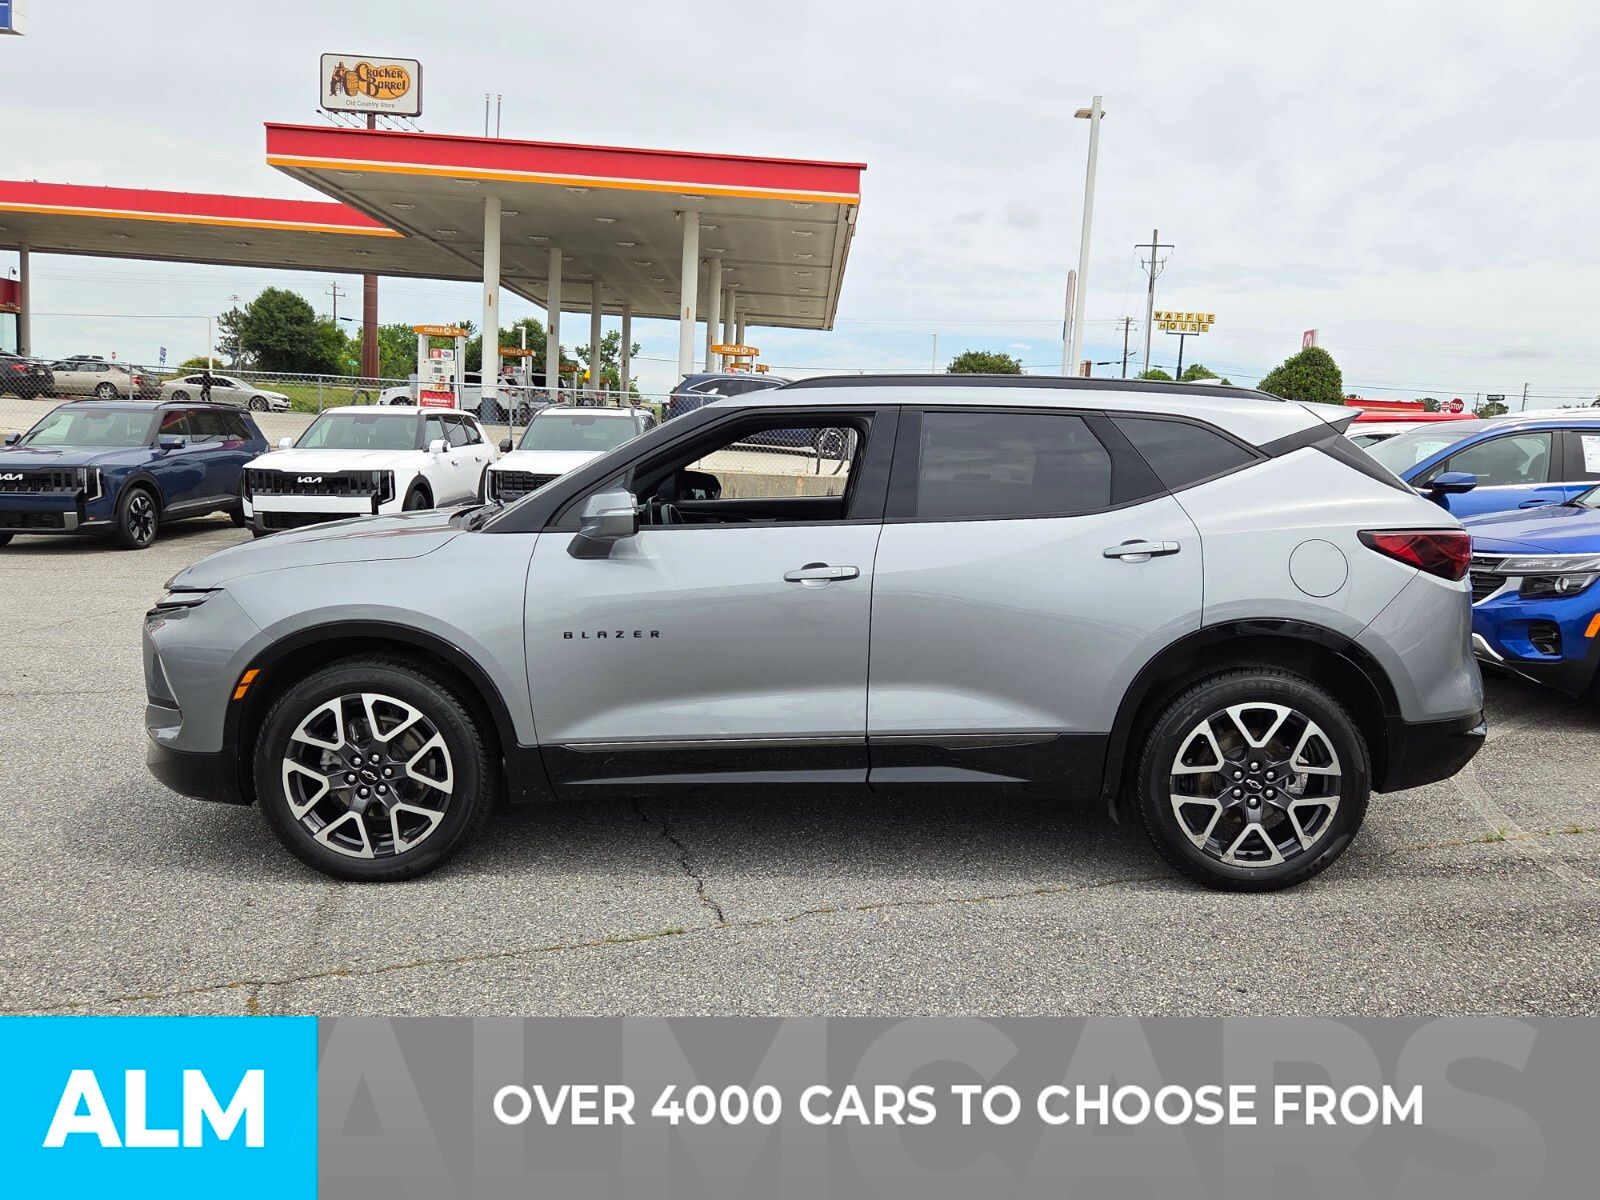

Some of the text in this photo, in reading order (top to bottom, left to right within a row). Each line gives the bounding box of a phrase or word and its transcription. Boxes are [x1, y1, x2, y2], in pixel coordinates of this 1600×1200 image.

[354, 63, 403, 82] Cracker
[366, 77, 406, 97] Barrel
[345, 99, 356, 107] Old
[1155, 311, 1215, 322] WAFFLE
[1159, 322, 1208, 331] HOUSE
[1450, 403, 1464, 411] STOP
[563, 630, 660, 639] BLAZER
